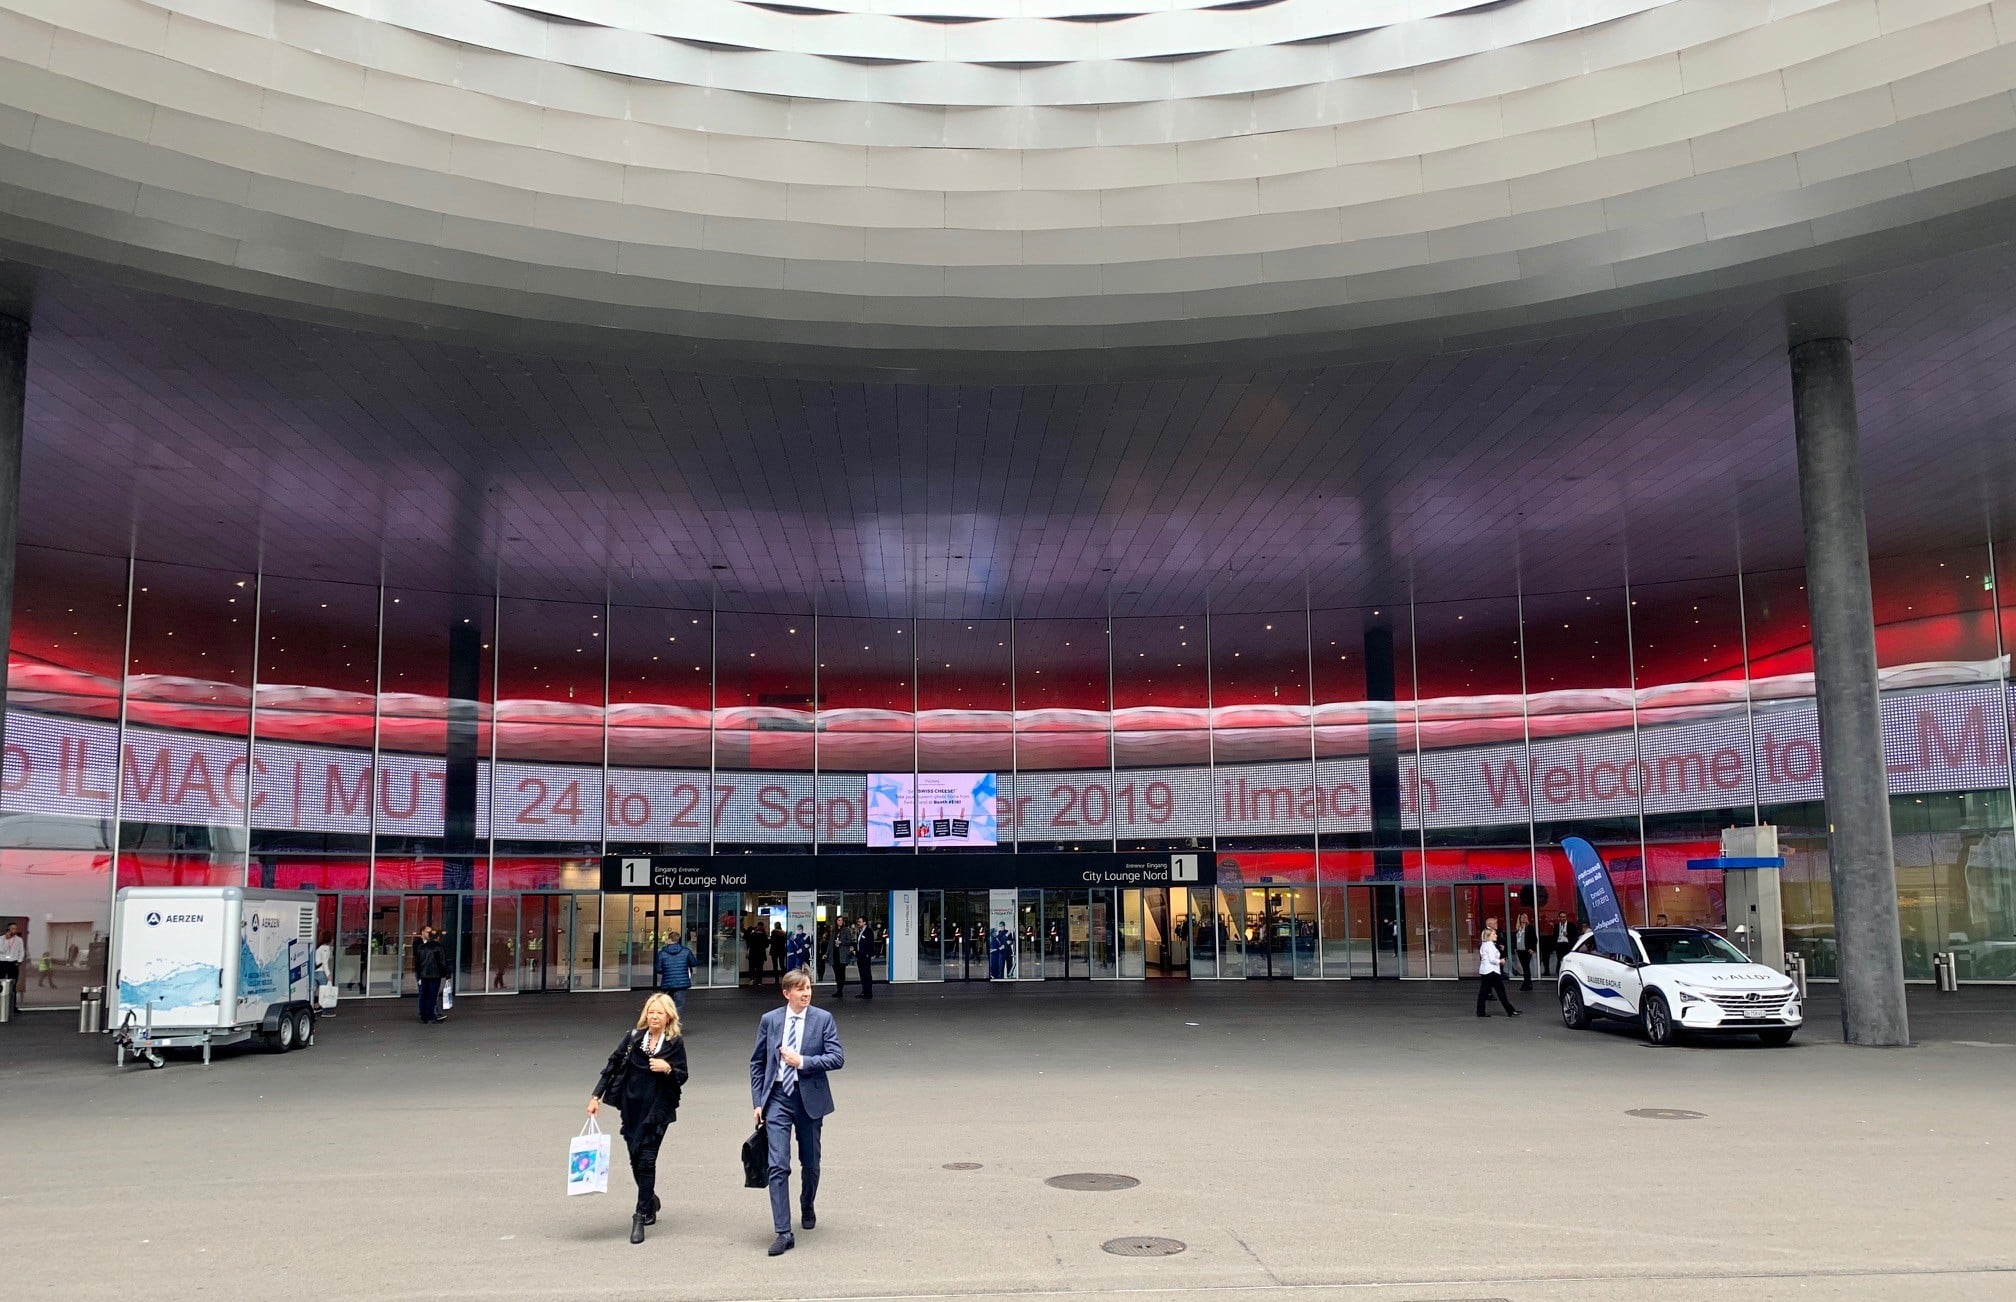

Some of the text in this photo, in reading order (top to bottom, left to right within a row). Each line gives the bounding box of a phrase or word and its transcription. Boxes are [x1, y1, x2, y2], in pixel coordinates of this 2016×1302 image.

[59, 736, 268, 811] ILMAC
[515, 778, 586, 826] 24
[606, 783, 650, 828] to
[670, 783, 737, 829] 27
[1051, 781, 1173, 827] 2019
[1481, 747, 1744, 809] Welcome
[1763, 733, 1819, 785] to
[625, 862, 635, 883] 1
[654, 866, 678, 874] Eingang
[1146, 862, 1168, 870] Eingang
[1174, 858, 1184, 878] 1
[654, 873, 747, 888] City Lounge Nord
[1082, 869, 1168, 884] City Lounge Nord
[166, 914, 204, 923] AERZEN
[261, 917, 280, 928] AERZEN
